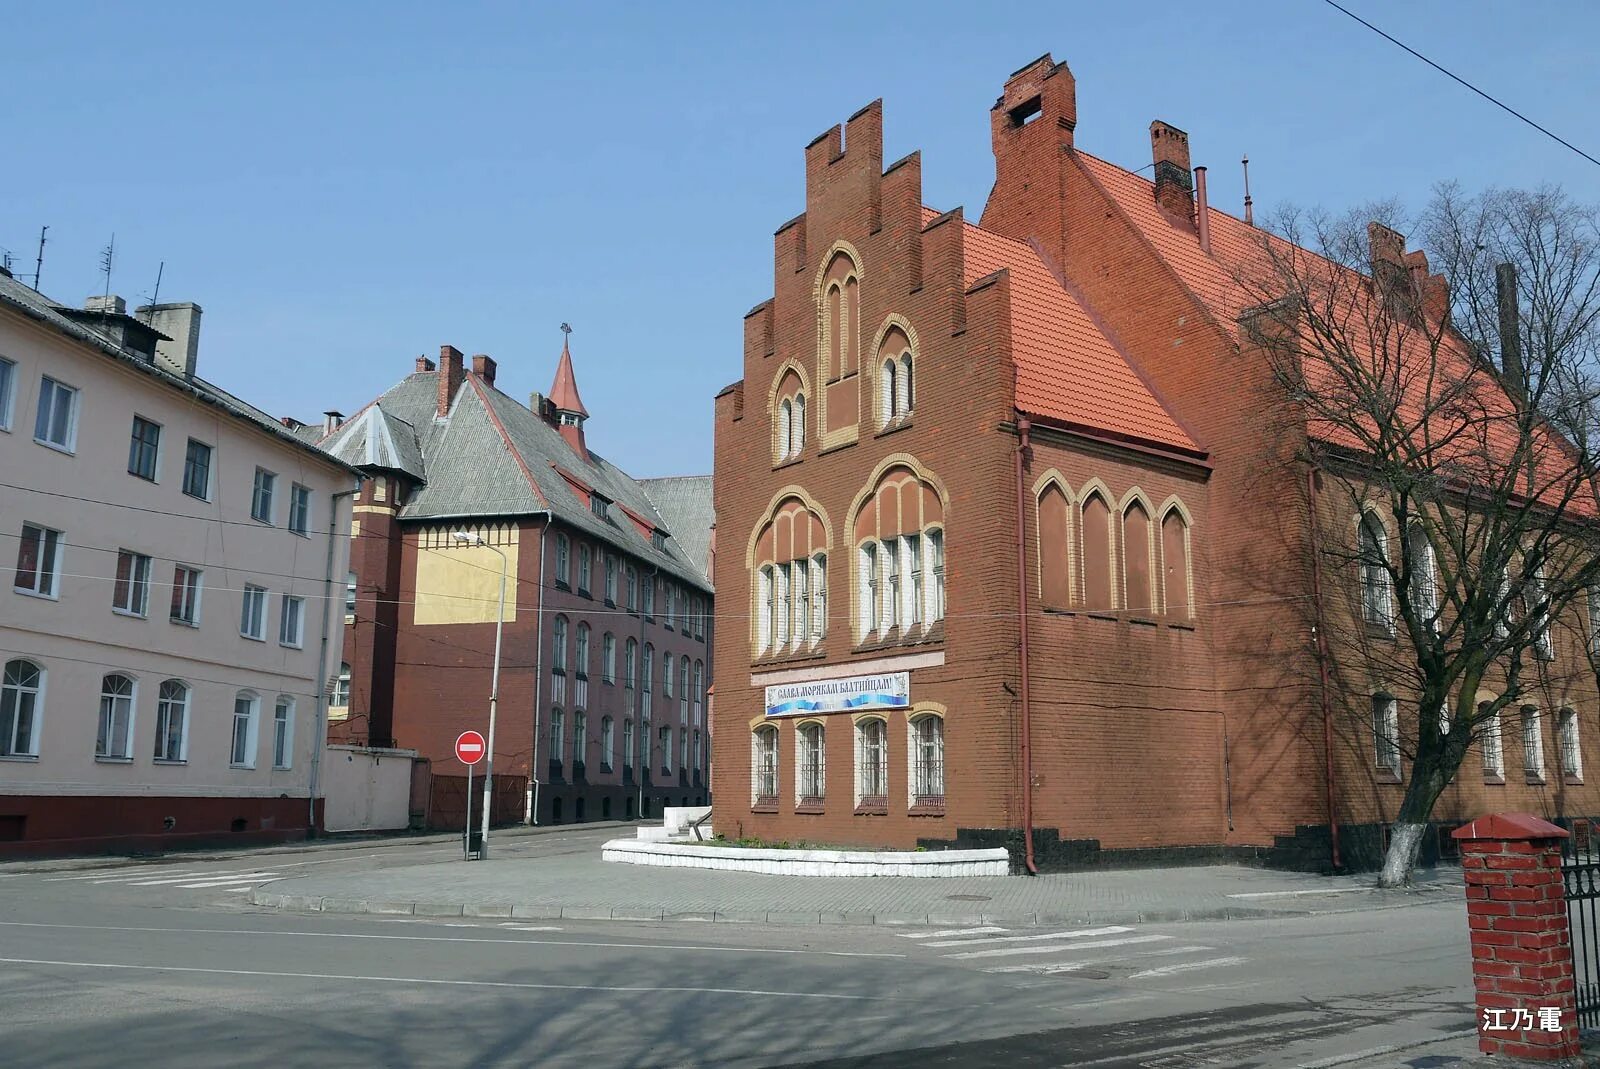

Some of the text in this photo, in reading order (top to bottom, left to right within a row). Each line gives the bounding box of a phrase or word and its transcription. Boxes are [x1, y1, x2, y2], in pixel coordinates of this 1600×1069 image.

[777, 677, 892, 699] СЛАВА МОРЯКАМ БАЛТИЙЦАМ!
